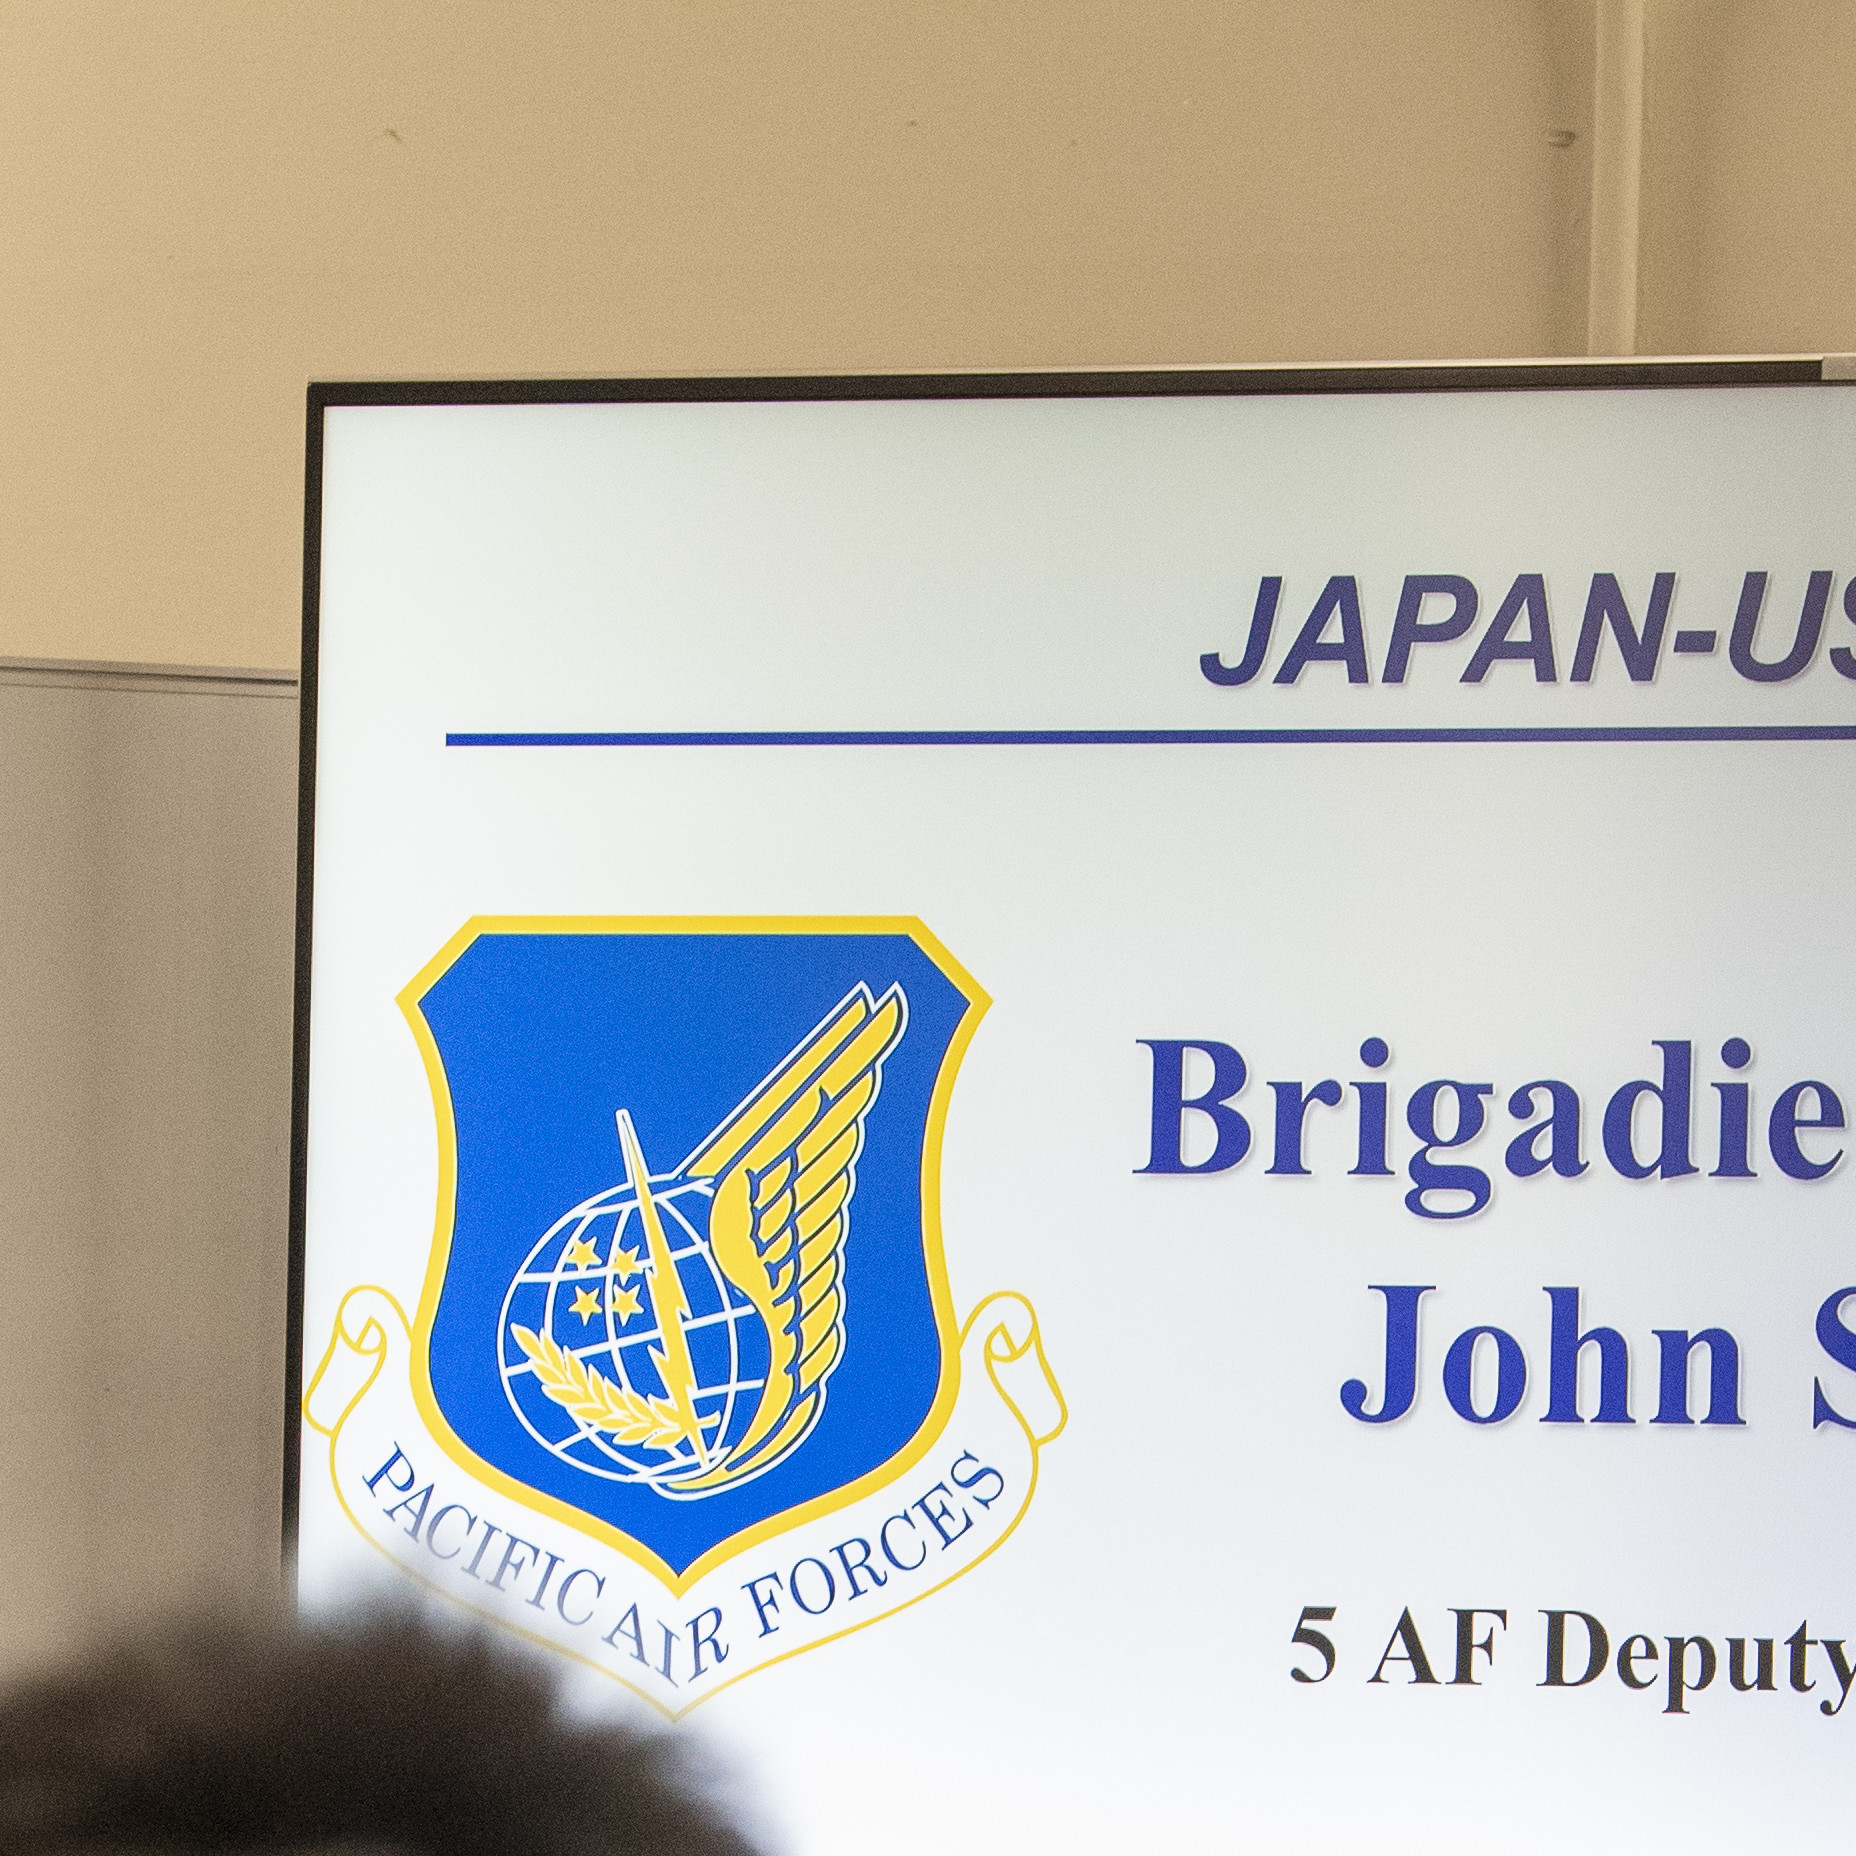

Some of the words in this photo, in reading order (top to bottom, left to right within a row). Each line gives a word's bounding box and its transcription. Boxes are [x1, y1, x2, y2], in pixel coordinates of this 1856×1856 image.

[1339, 1285, 1747, 1428] John
[361, 1440, 607, 1627] PACIFIC
[602, 1602, 730, 1689] AIR
[740, 1448, 1008, 1640] FORCES
[1290, 1606, 1337, 1684] 5
[1369, 1607, 1508, 1686] AF
